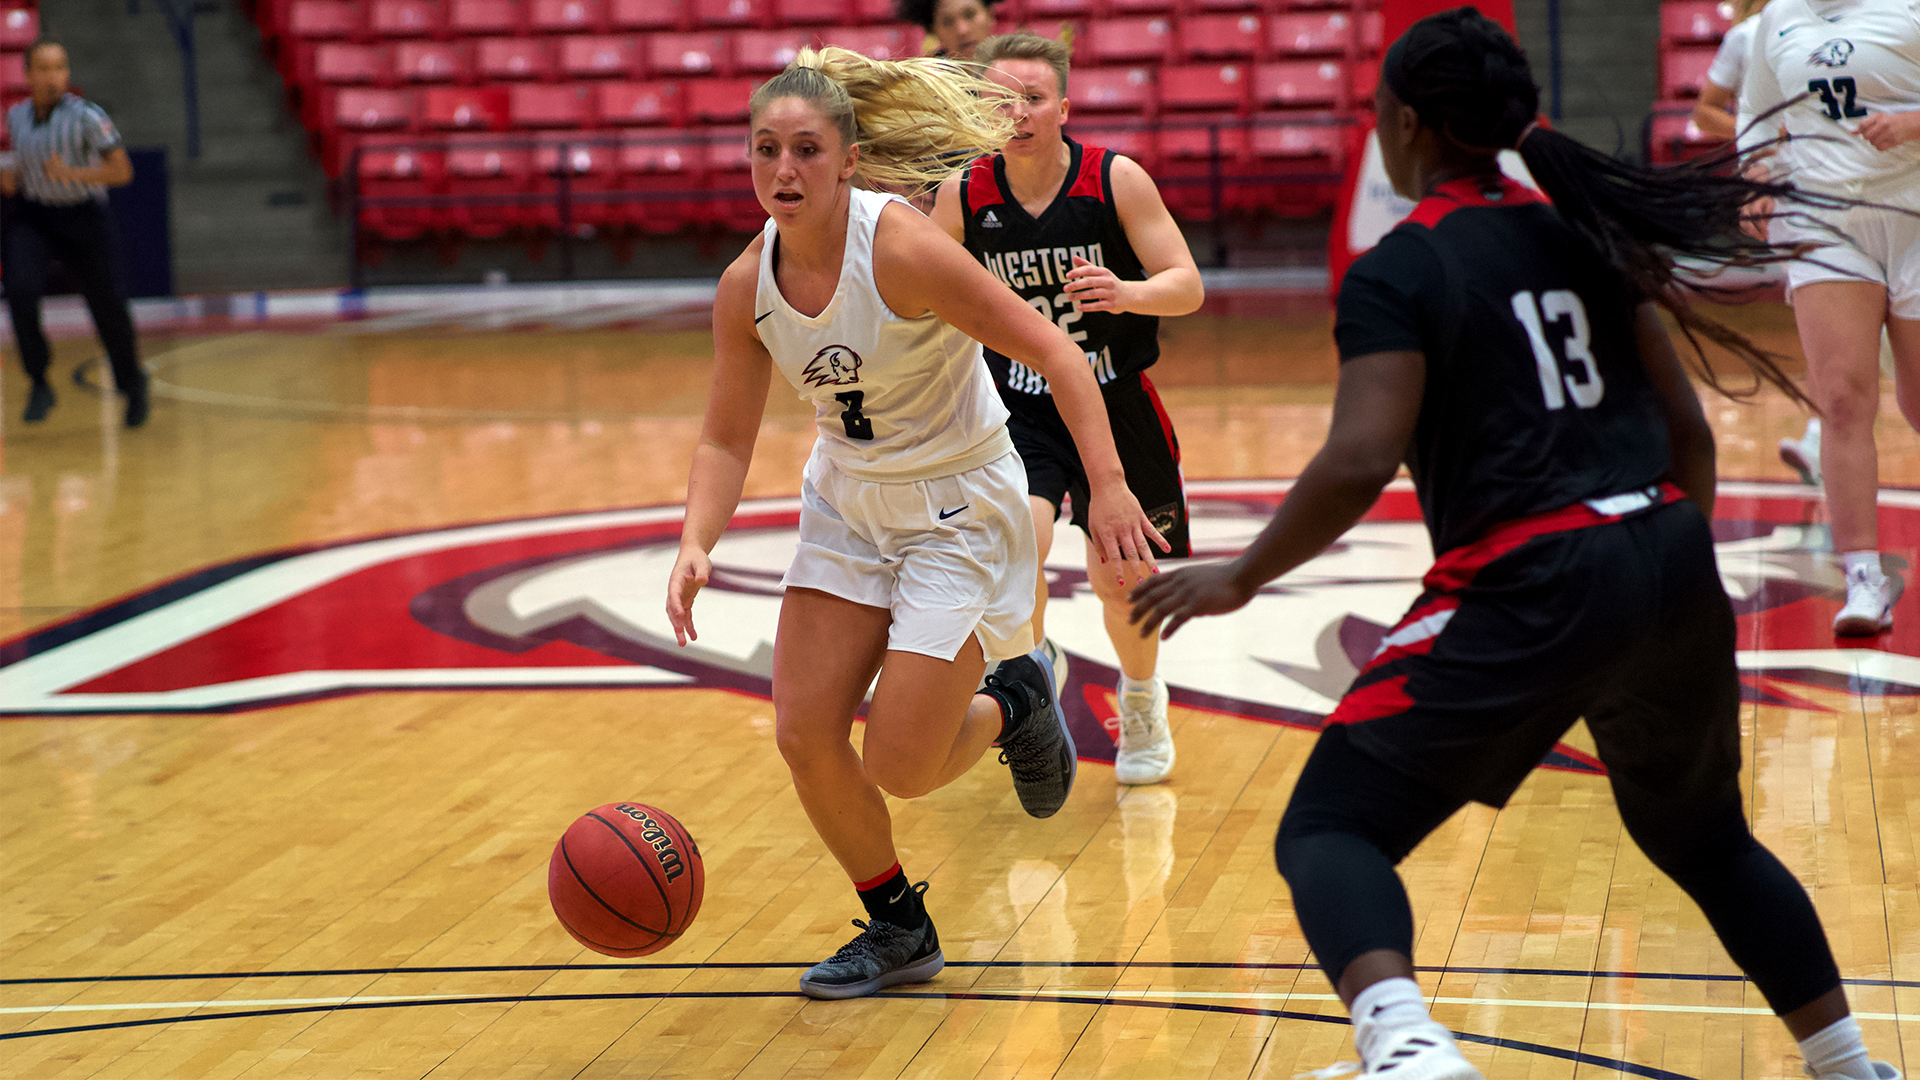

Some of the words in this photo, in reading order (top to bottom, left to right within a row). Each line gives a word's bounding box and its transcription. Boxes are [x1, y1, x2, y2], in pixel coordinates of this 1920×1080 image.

[1808, 77, 1868, 120] 32
[1510, 288, 1605, 411] 13
[833, 390, 874, 440] 2
[614, 803, 685, 885] Wilson
